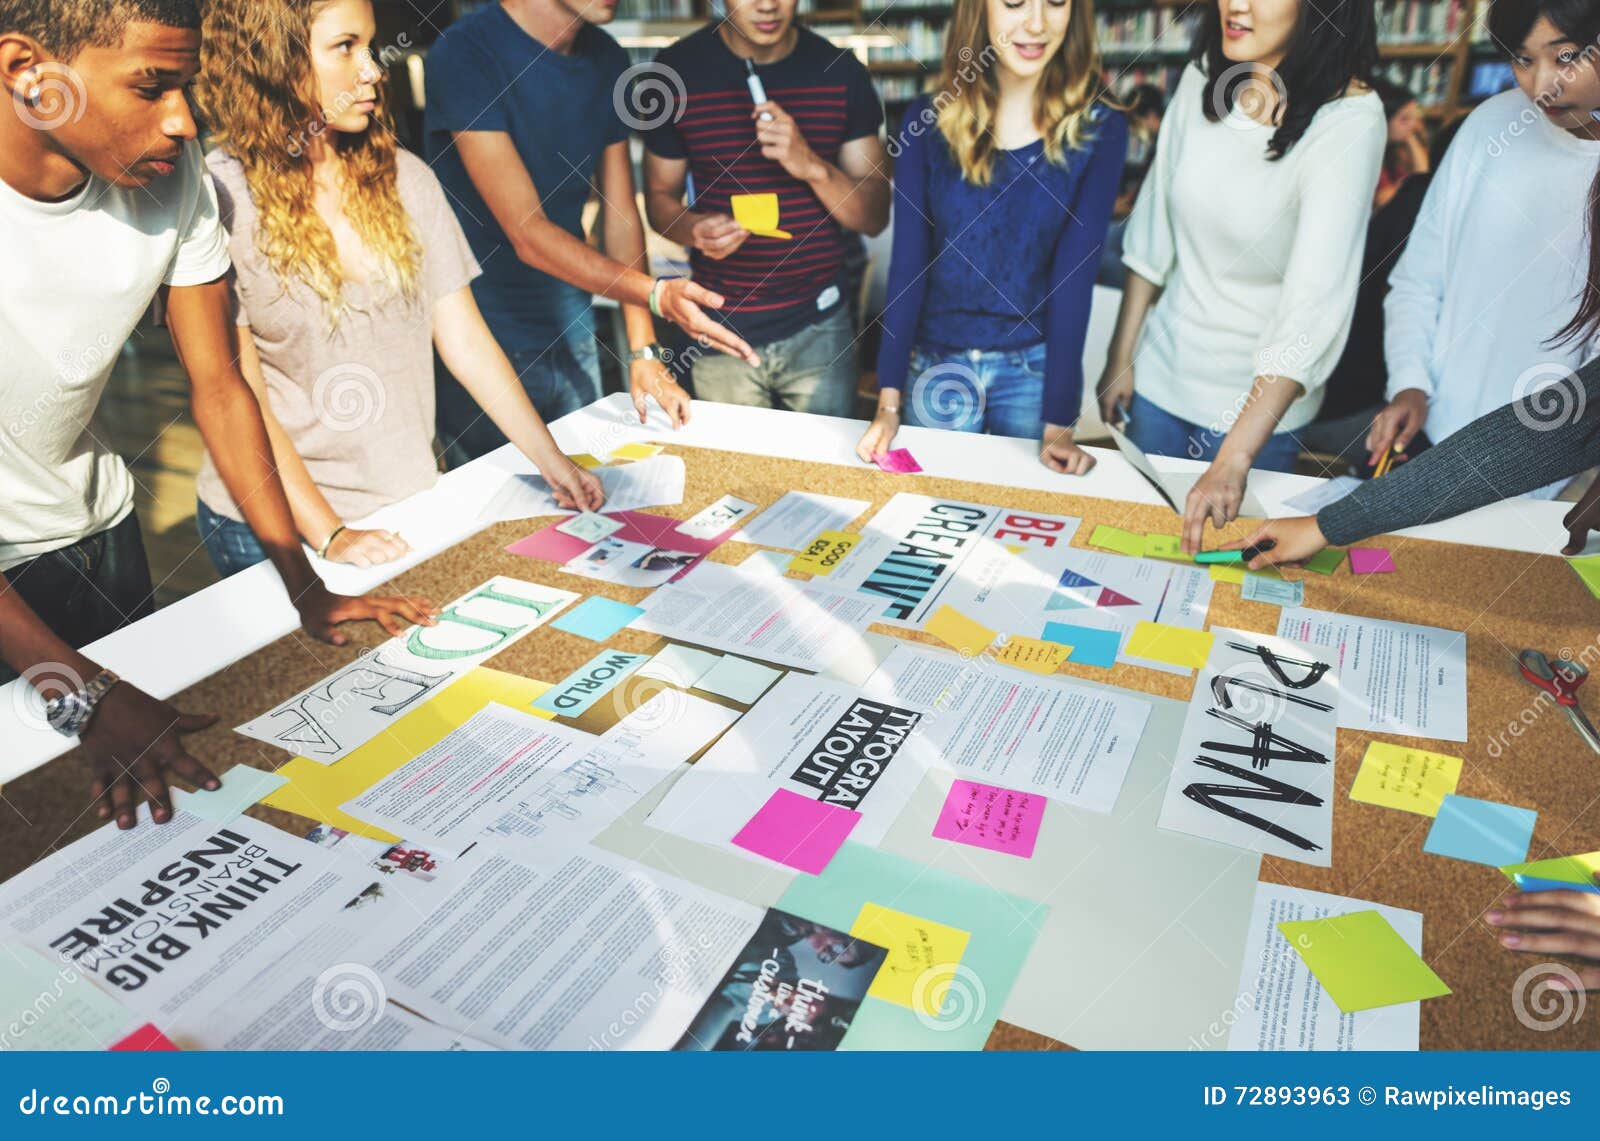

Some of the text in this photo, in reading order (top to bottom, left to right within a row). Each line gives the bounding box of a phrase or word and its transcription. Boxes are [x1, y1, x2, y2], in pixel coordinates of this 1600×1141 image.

[819, 541, 851, 566] GOOD
[994, 514, 1066, 547] BE
[270, 584, 565, 755] IDEA
[554, 654, 638, 710] WORLD
[800, 703, 884, 787] LAYOUT
[825, 711, 920, 808] TYPOGRA
[1182, 640, 1335, 852] PLAN
[48, 828, 251, 960] INSPIRE
[79, 844, 268, 973] BRAINSTORM
[174, 856, 302, 940] THINK
[106, 932, 192, 992] BIG
[784, 978, 830, 1033] think
